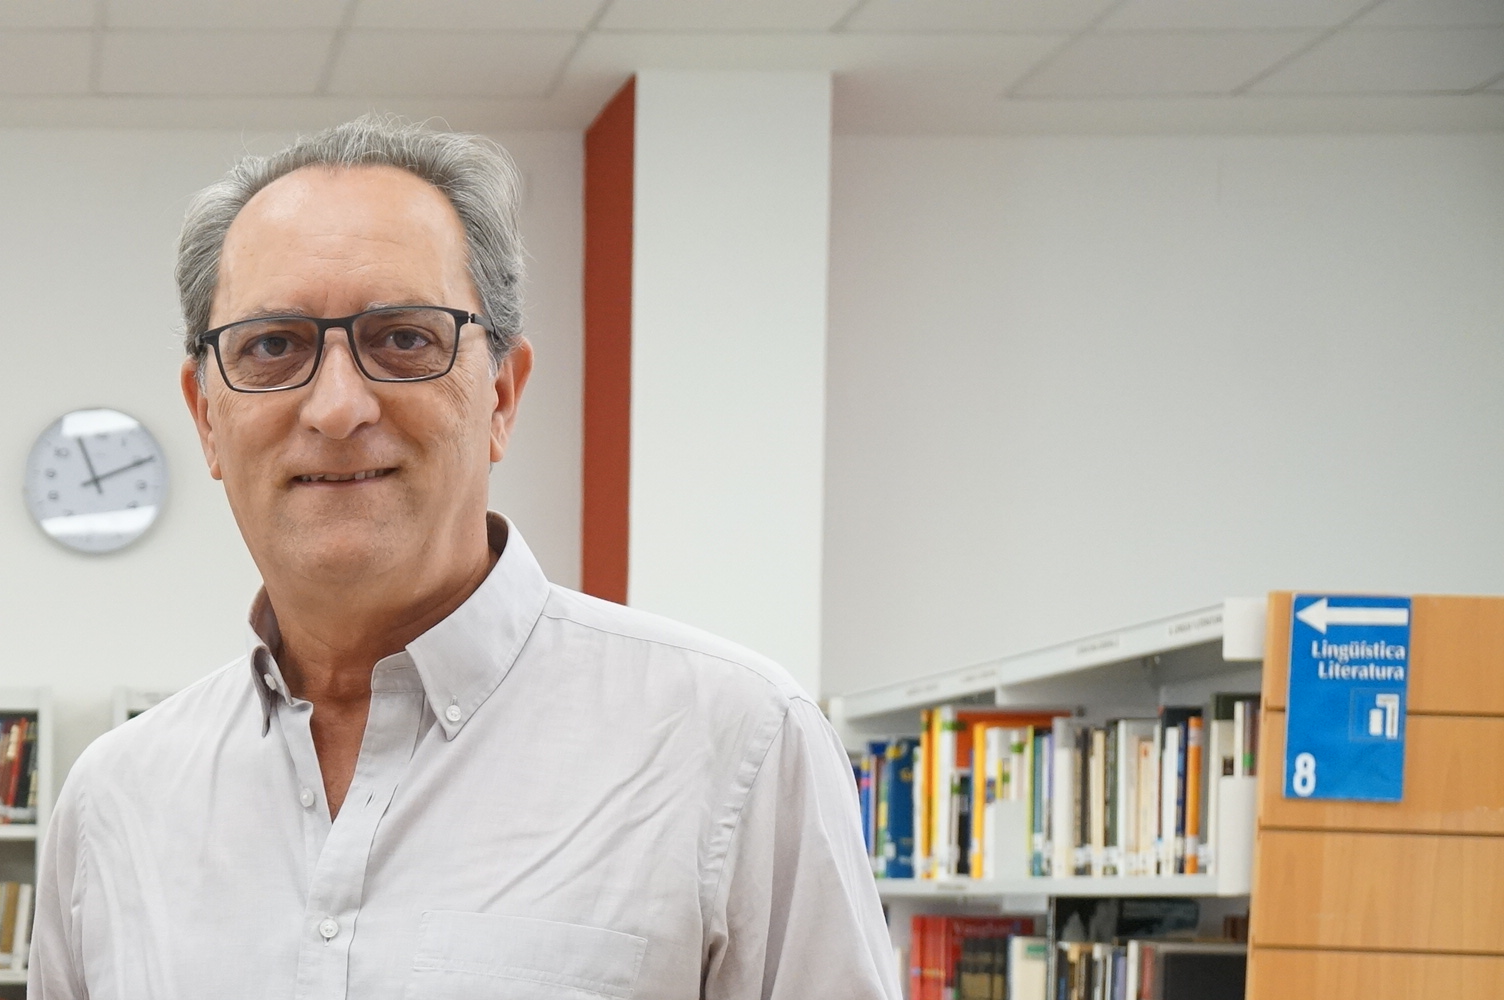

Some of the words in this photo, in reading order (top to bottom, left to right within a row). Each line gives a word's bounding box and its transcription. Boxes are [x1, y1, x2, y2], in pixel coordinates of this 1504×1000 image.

[1312, 640, 1406, 663] Lingüística
[1318, 660, 1404, 680] Literatura
[1293, 752, 1316, 797] 8
